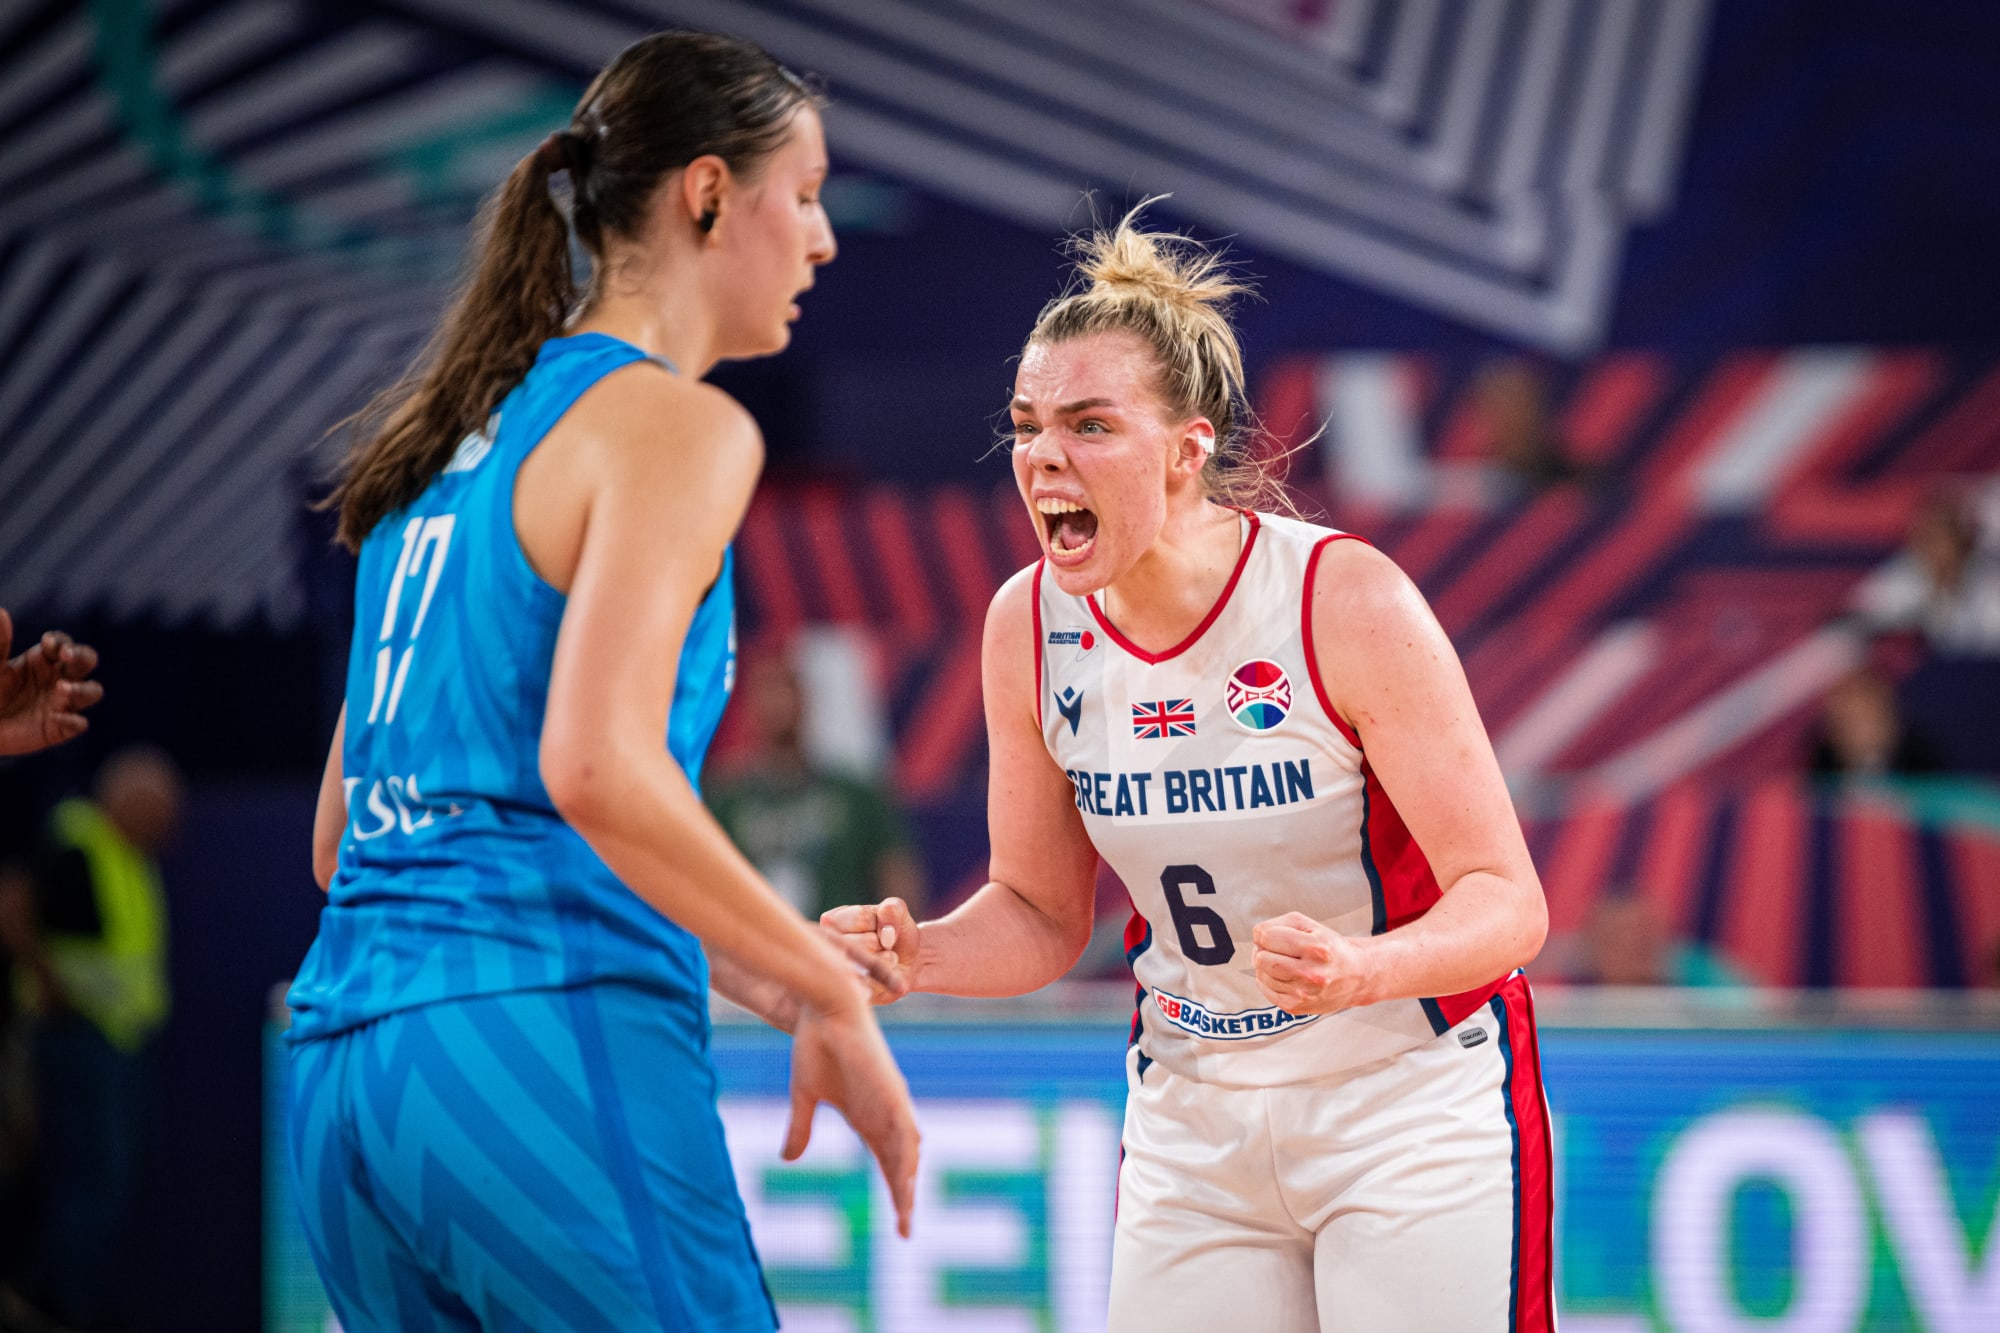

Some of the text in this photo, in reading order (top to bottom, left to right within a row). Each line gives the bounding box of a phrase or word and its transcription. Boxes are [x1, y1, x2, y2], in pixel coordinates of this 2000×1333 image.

[366, 513, 456, 724] 17
[1049, 631, 1081, 639] BRITISH
[1066, 758, 1315, 817] GREAT BRITAIN
[1160, 864, 1236, 966] 6
[1156, 994, 1313, 1034] GBBASKETBA
